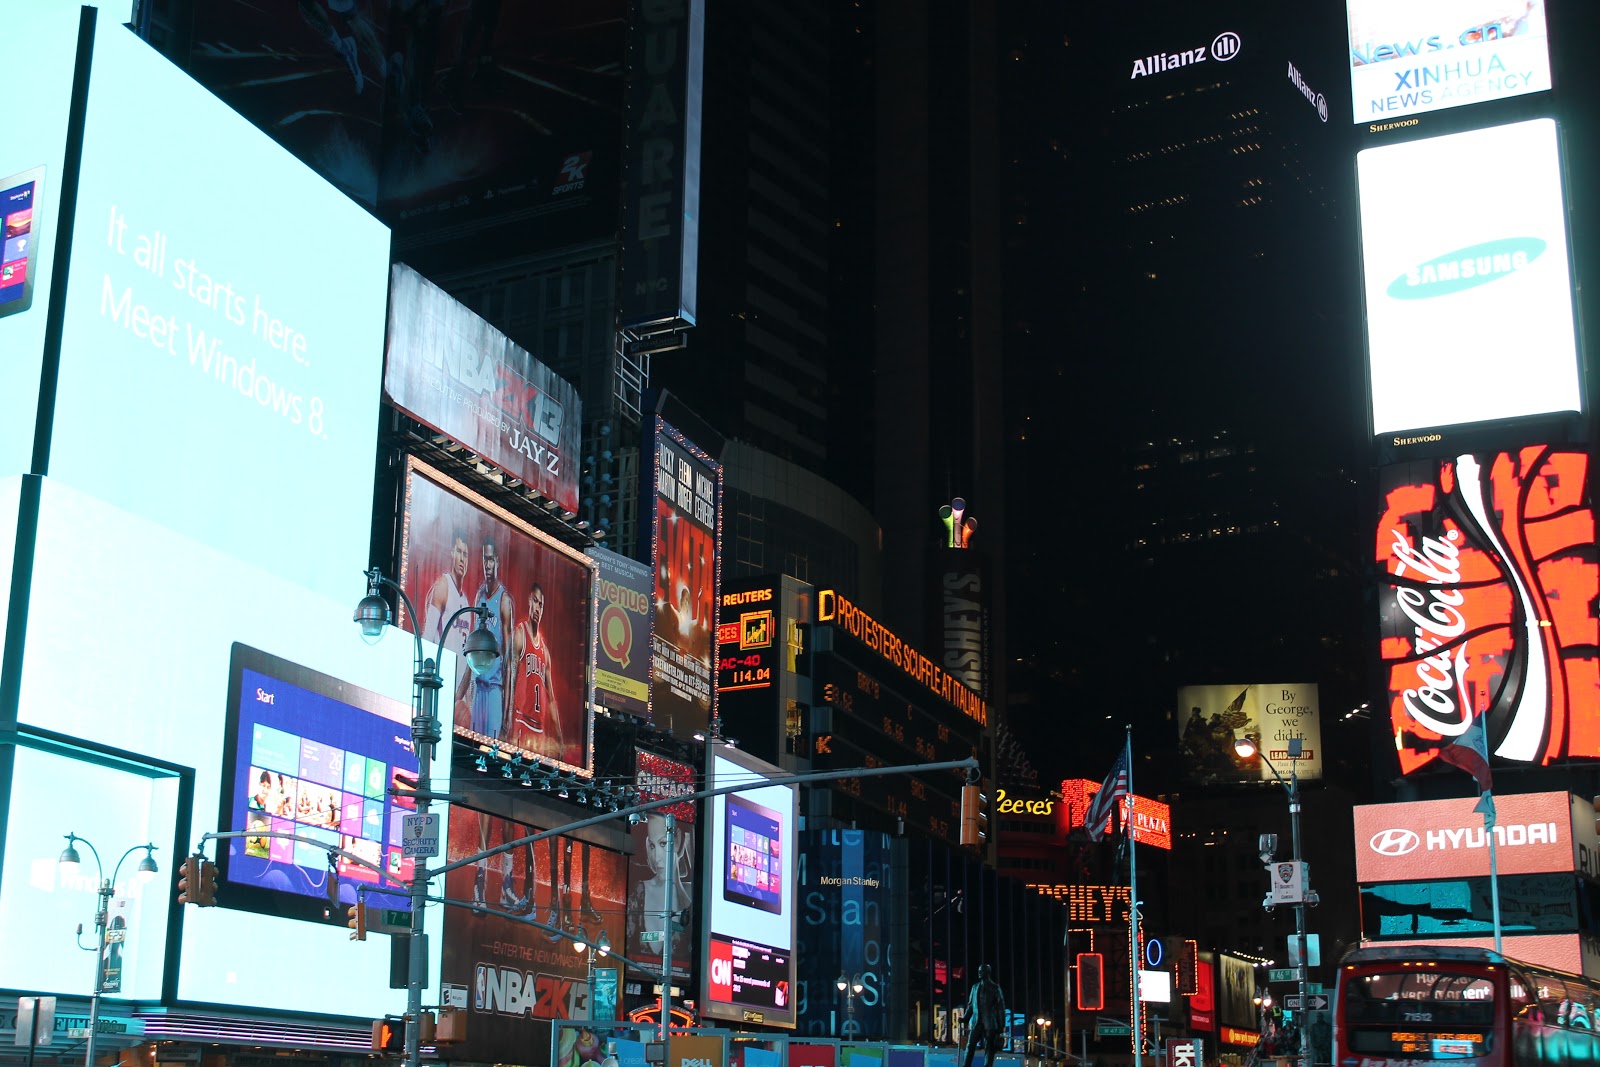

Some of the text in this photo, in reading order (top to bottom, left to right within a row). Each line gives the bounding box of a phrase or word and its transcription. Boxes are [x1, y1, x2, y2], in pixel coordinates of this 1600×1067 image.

[1131, 46, 1206, 80] Allianz
[1394, 53, 1506, 91] XINHUA
[1287, 61, 1317, 108] Allianz
[1371, 71, 1533, 114] NEWS AGENCY
[559, 154, 590, 182] 2K
[551, 179, 586, 196] SPORTS
[1404, 250, 1529, 287] SAMSUNG
[107, 204, 311, 368] It all starts here.
[101, 271, 179, 357] Meet
[186, 321, 303, 425] Windows
[462, 397, 500, 428] PRODUCED
[500, 421, 511, 434] BY
[508, 427, 560, 477] JAY Z
[588, 549, 616, 567] BROADWAY'S
[655, 498, 714, 632] EVITA
[601, 563, 635, 580] BEST MUSICAL
[600, 579, 649, 615] venue
[723, 588, 772, 606] REUTERS
[600, 603, 633, 670] Q
[1392, 528, 1473, 736] Coca-Cola
[818, 589, 835, 622] D
[838, 594, 902, 668] PROTESTERS
[903, 644, 941, 696] SCUFFLE
[941, 672, 952, 702] AT
[733, 667, 770, 684] 114.04
[255, 687, 275, 705] Start
[1281, 689, 1297, 702] By
[1265, 703, 1314, 718] George,
[1282, 718, 1299, 727] we
[1273, 729, 1293, 742] did
[329, 751, 343, 771] 26
[1270, 751, 1311, 760] LEADHIP
[407, 815, 433, 827] NYPD
[1137, 812, 1167, 833] PLAZA
[403, 837, 438, 847] SECURITY
[1426, 822, 1557, 851] HYUNDAI
[404, 846, 436, 855] CAMERA
[820, 876, 880, 889] Morgan Stanley
[390, 911, 397, 924] 7
[493, 941, 583, 968] ENTER THE NEW DYNASTY
[711, 957, 732, 987] CNN
[1276, 970, 1284, 979] 46
[443, 989, 450, 1005] E
[1289, 999, 1301, 1007] ONE
